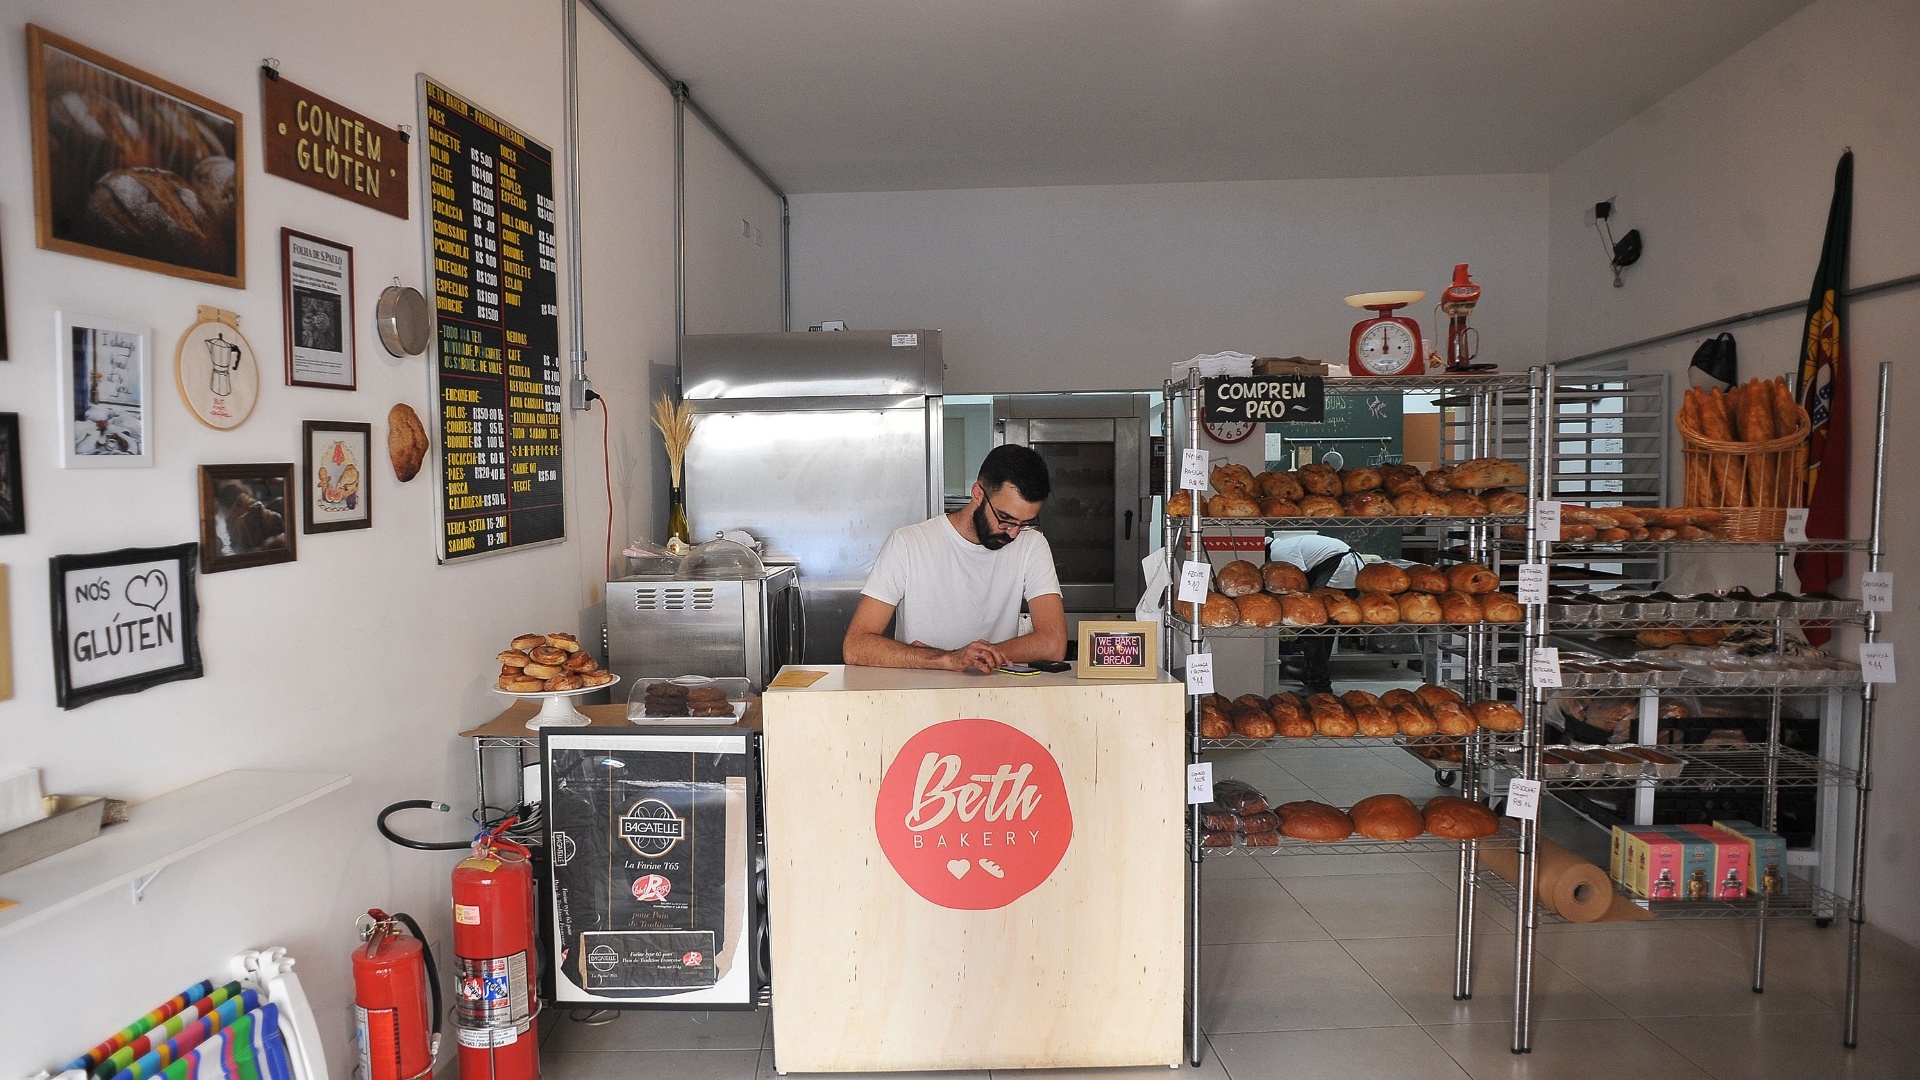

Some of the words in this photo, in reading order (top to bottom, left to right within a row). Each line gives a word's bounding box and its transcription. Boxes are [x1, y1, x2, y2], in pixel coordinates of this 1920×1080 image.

[431, 163, 453, 183] AZEITE
[501, 176, 522, 195] SIMPLES
[433, 198, 463, 222] FOCACCIA
[434, 219, 467, 242] CROISSANT
[293, 243, 312, 258] FOLHA
[313, 250, 320, 260] DE
[436, 257, 468, 278] INTEGRAIS
[437, 278, 469, 298] ESPECIAIS
[437, 296, 463, 314] BRIOCHE
[1217, 382, 1306, 400] COMPREM
[1246, 400, 1286, 419] PÃO
[1226, 431, 1232, 439] 6
[1236, 428, 1242, 436] 5
[76, 577, 110, 603] NÓS
[74, 612, 173, 663] GLÚTEN
[1098, 637, 1112, 645] WE
[1115, 637, 1137, 645] BAKE
[1097, 646, 1115, 655] OUR
[1118, 646, 1139, 655] OWN
[1103, 655, 1133, 665] BREAD
[905, 752, 1042, 831] Beth
[625, 822, 679, 835] BAGATELLE
[913, 831, 1039, 848] BAKERY
[624, 860, 635, 869] La
[637, 861, 662, 871] Farine
[664, 862, 680, 871] T65
